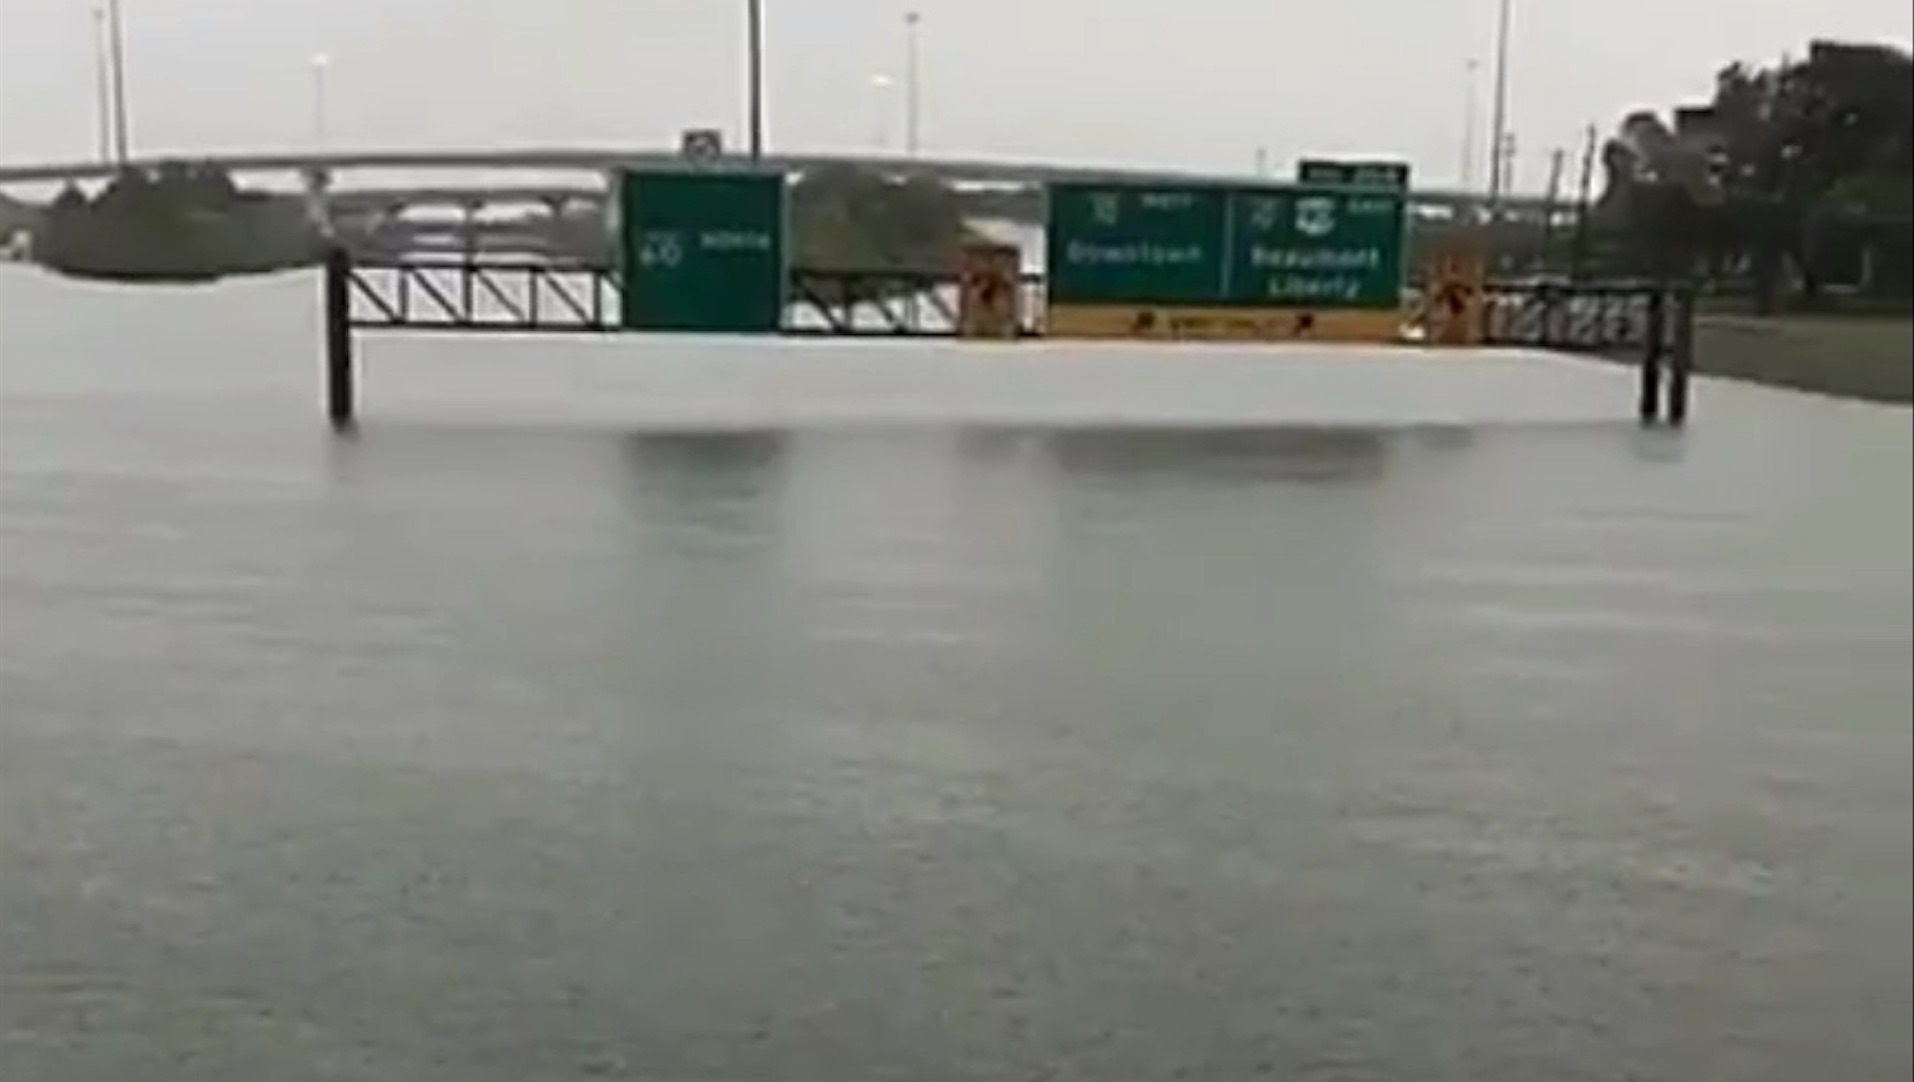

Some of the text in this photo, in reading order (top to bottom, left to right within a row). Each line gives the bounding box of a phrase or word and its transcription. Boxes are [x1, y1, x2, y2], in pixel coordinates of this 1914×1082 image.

[1067, 239, 1202, 266] Downtown
[1251, 246, 1380, 270] Beaumont
[1267, 275, 1361, 300] Liberty
